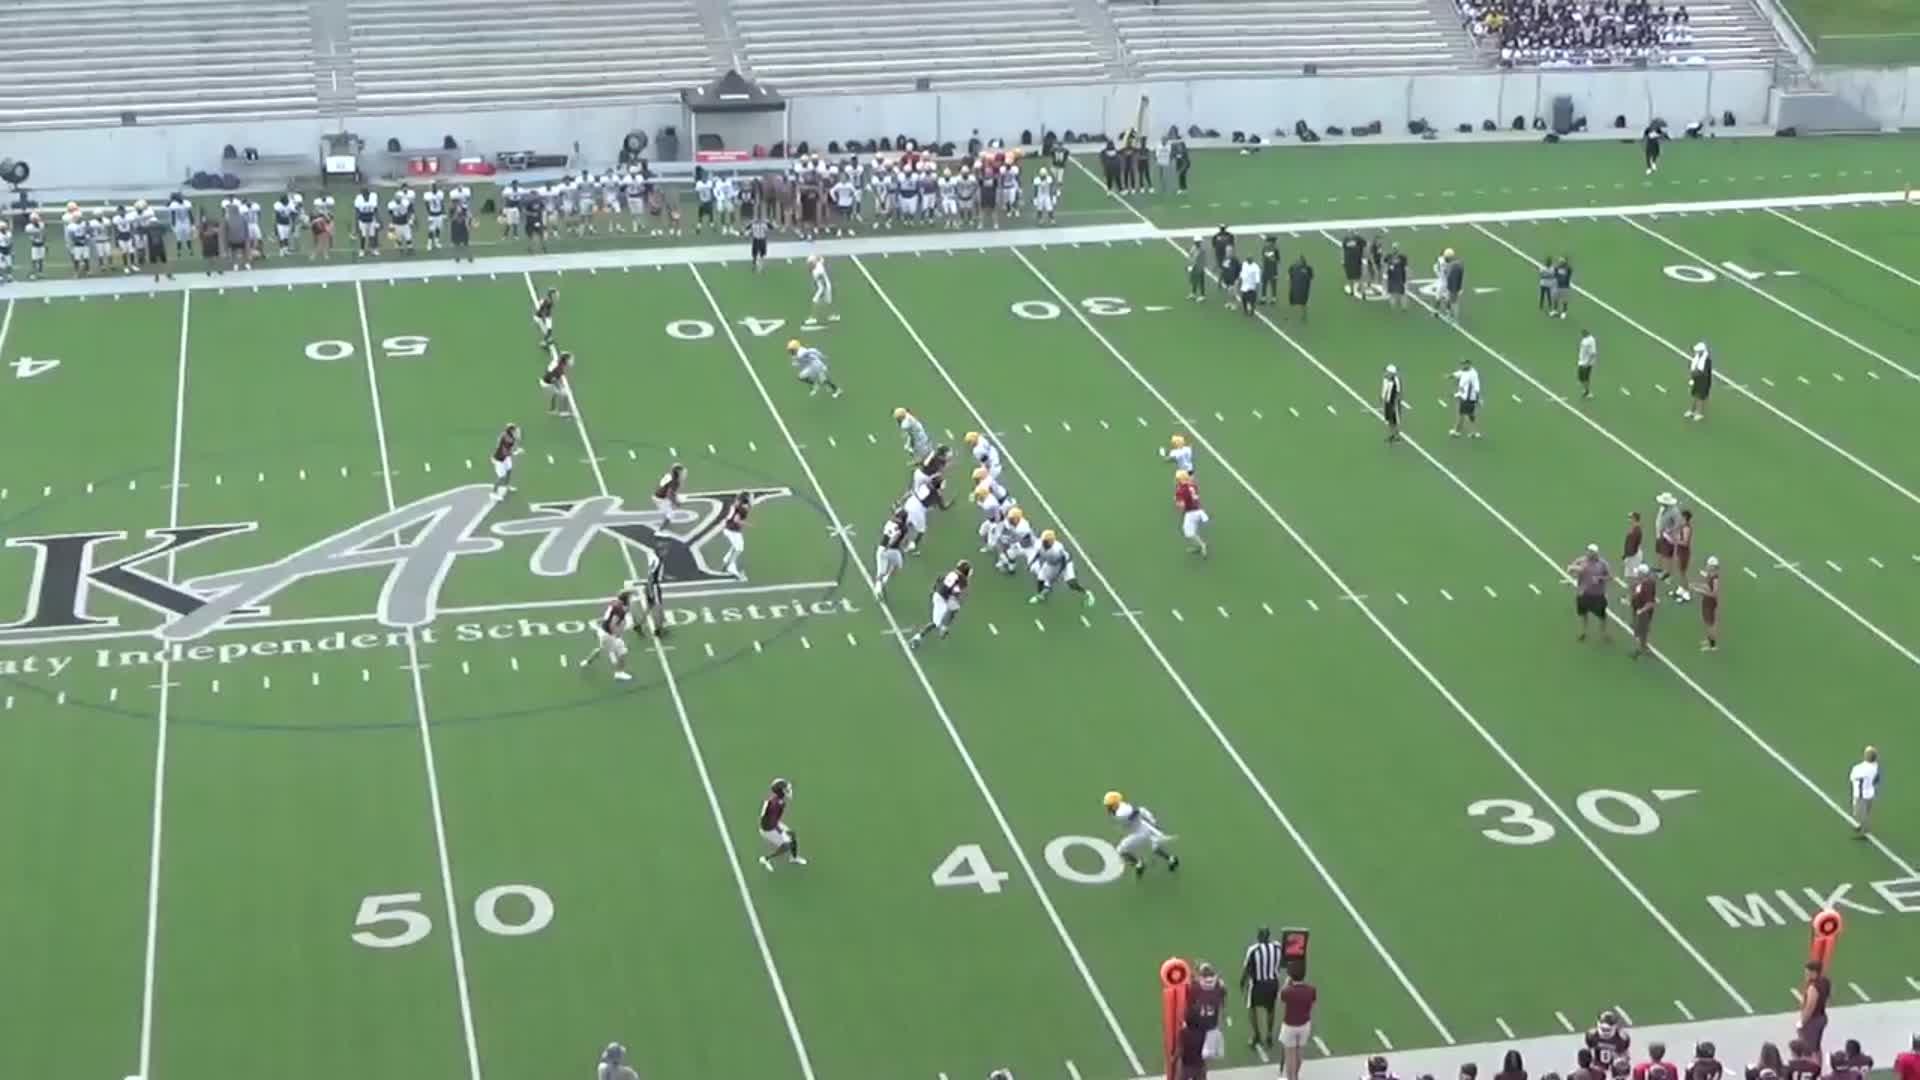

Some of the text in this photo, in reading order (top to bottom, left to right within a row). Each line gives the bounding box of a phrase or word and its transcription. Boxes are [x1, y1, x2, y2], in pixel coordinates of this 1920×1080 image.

[97, 630, 437, 668] Independent
[663, 597, 860, 627] District
[1706, 877, 1920, 927] MIKE
[1285, 933, 1304, 956] 2
